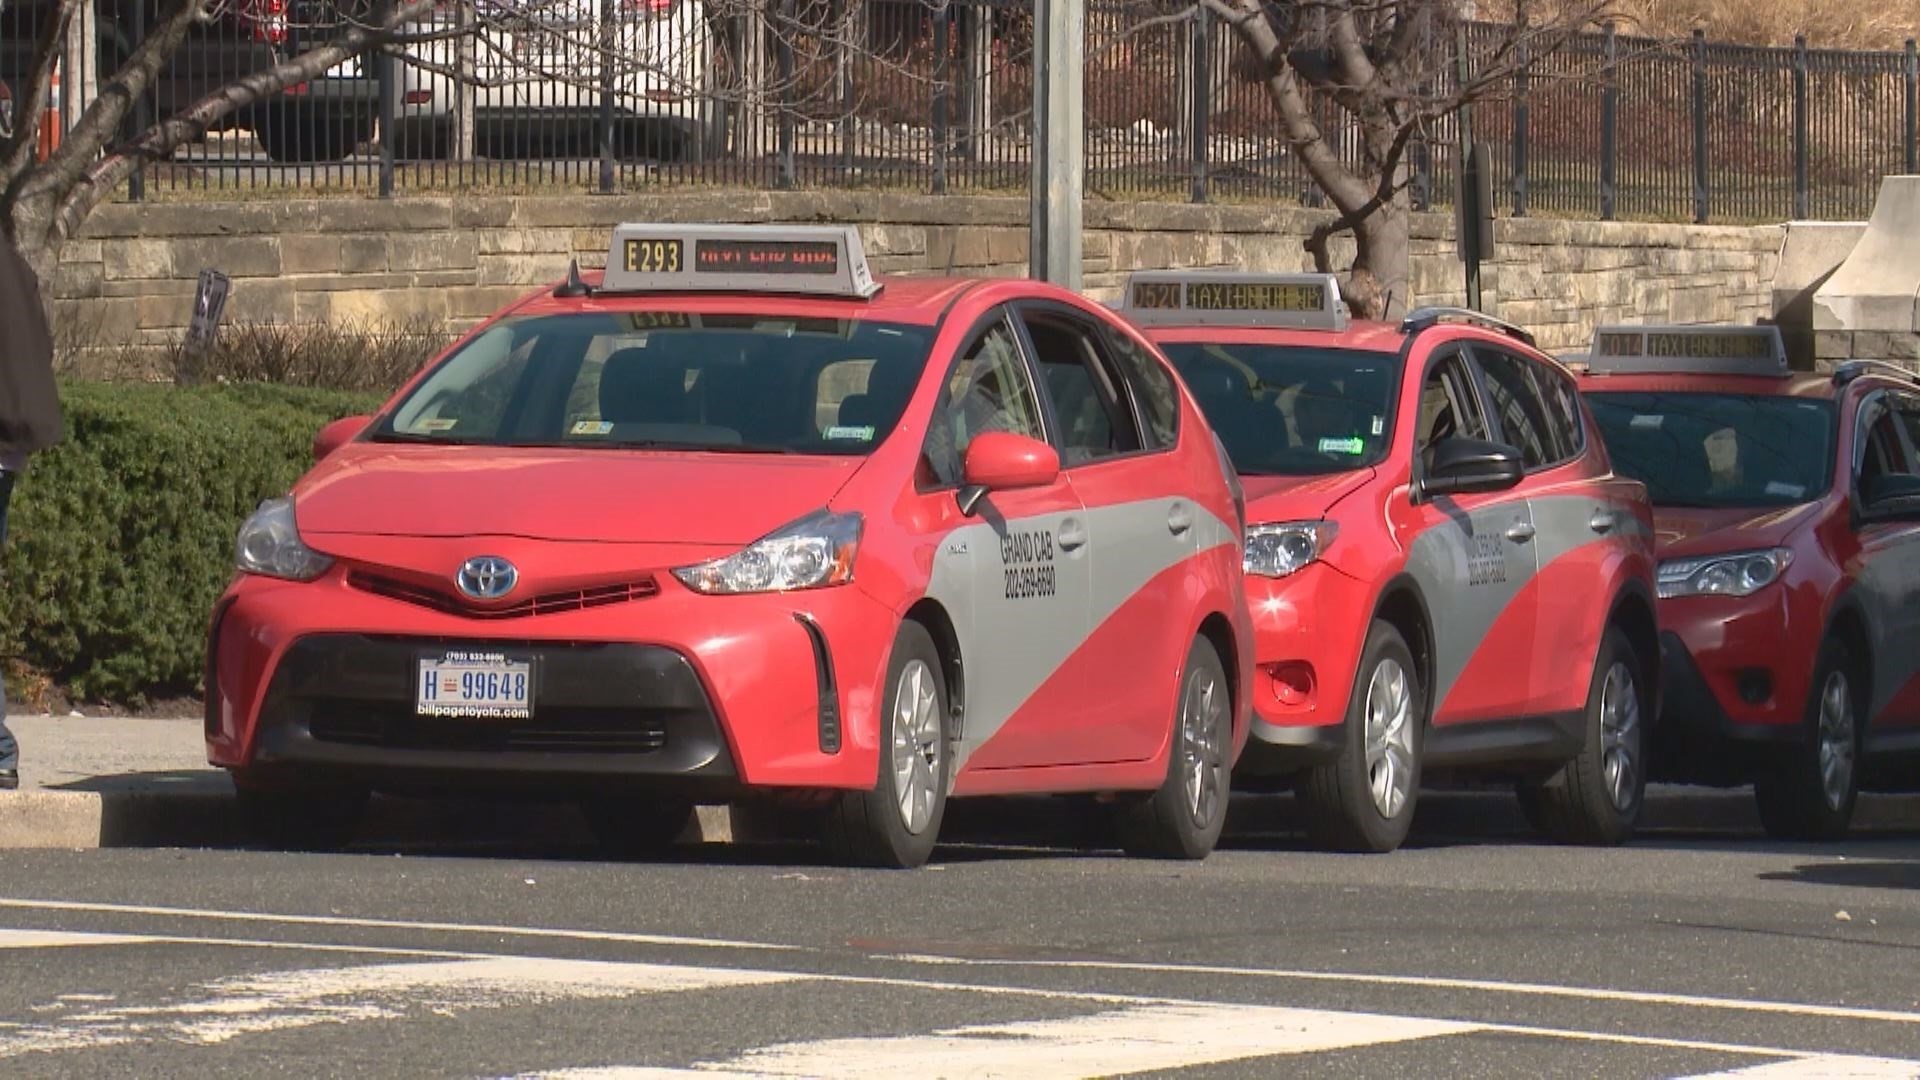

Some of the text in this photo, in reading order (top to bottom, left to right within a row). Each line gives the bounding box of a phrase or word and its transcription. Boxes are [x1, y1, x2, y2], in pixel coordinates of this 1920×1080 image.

[627, 241, 679, 273] E293
[1000, 531, 1054, 564] GRAND CAB
[425, 670, 525, 701] H 99648
